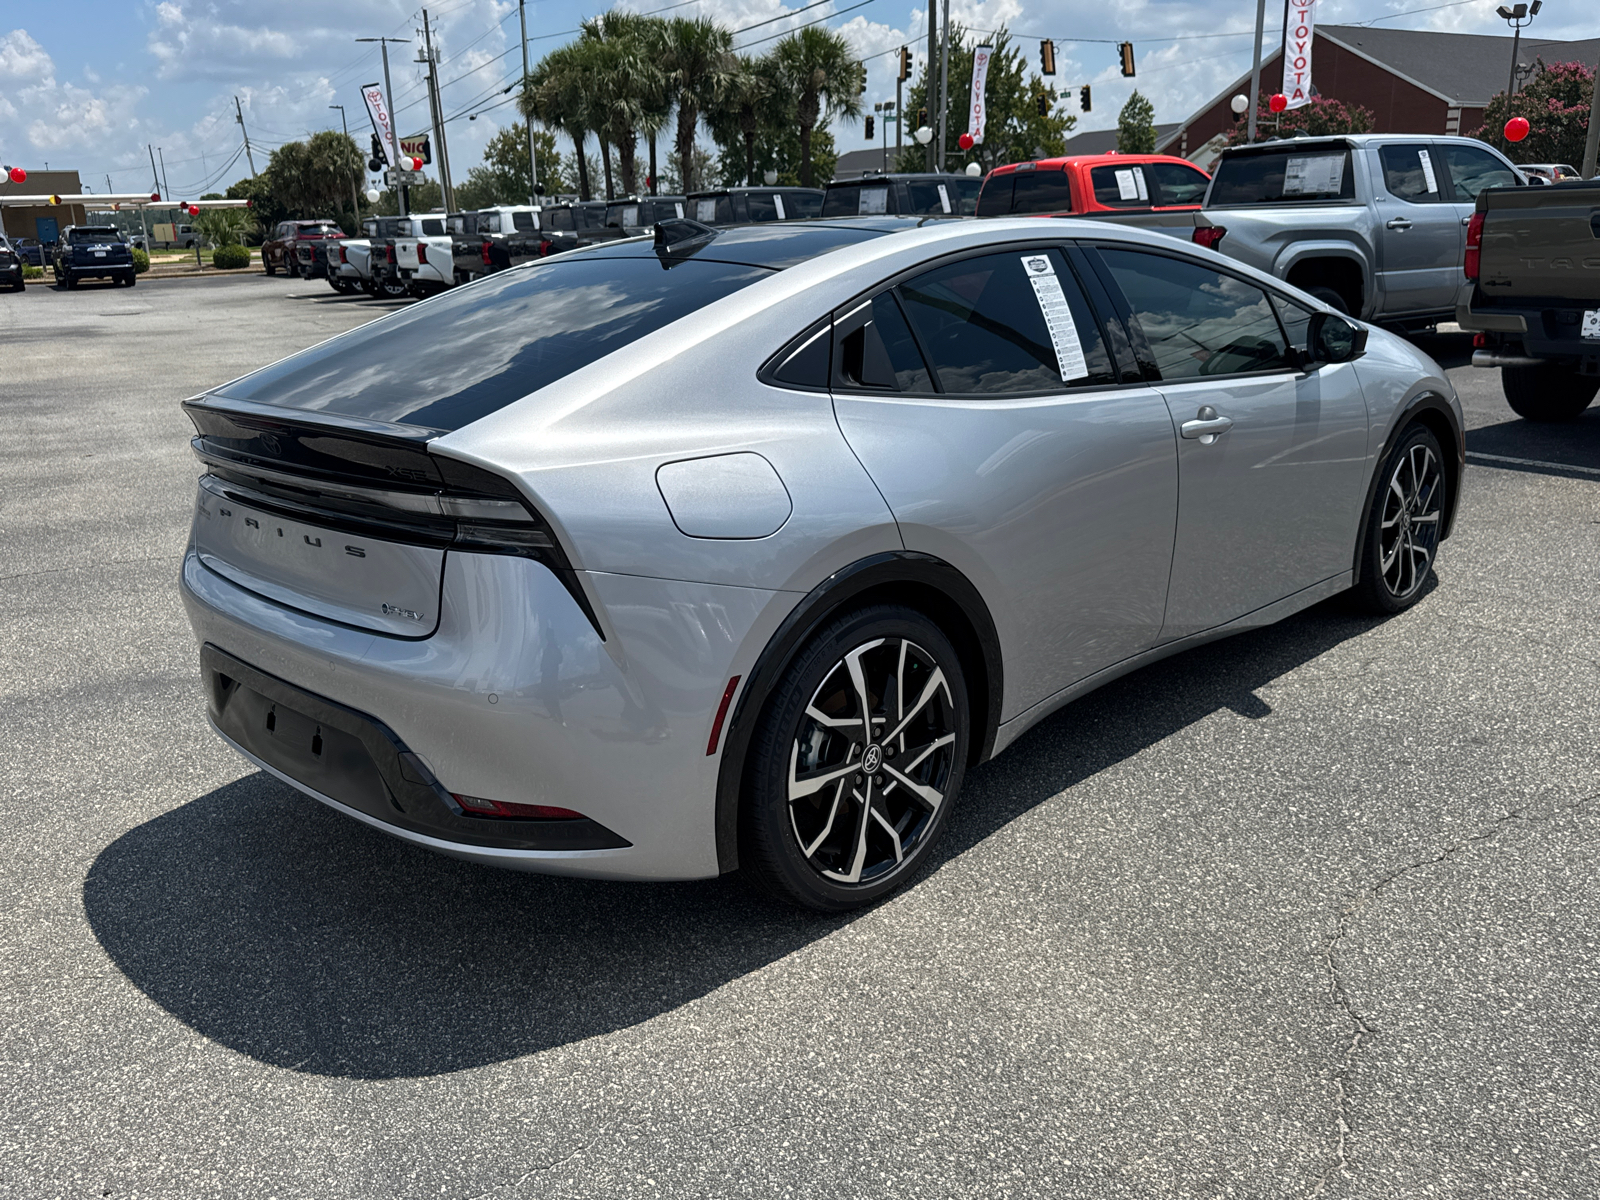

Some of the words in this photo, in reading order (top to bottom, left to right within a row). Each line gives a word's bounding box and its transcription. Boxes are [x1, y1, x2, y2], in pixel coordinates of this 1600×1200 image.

[1292, 10, 1309, 100] TOYOTA
[973, 68, 982, 137] TOYOTA
[385, 465, 427, 481] XSE
[220, 508, 367, 558] PRIUS
[771, 691, 801, 777] MICHELIN
